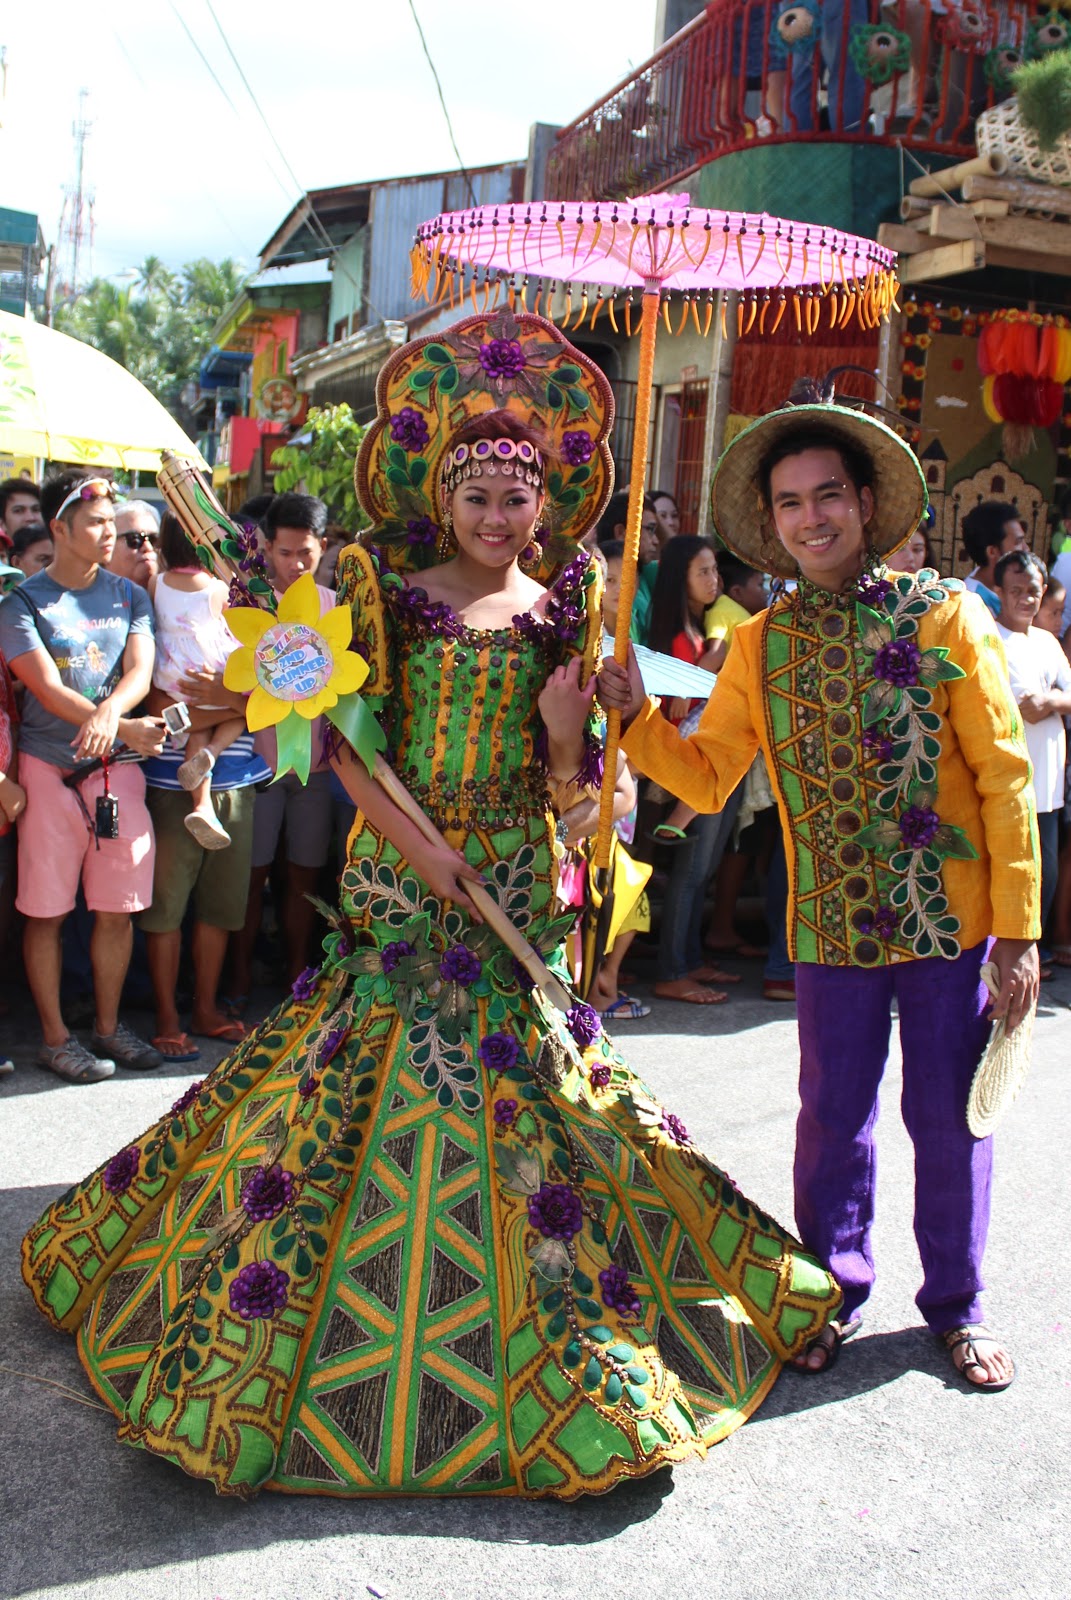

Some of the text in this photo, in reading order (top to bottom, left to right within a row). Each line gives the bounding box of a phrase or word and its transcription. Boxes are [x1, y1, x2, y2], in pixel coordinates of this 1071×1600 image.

[77, 617, 122, 630] SWIM
[55, 655, 86, 668] BIKE
[279, 649, 306, 669] 2ND
[272, 656, 327, 689] RUNNER
[294, 677, 316, 693] UP
